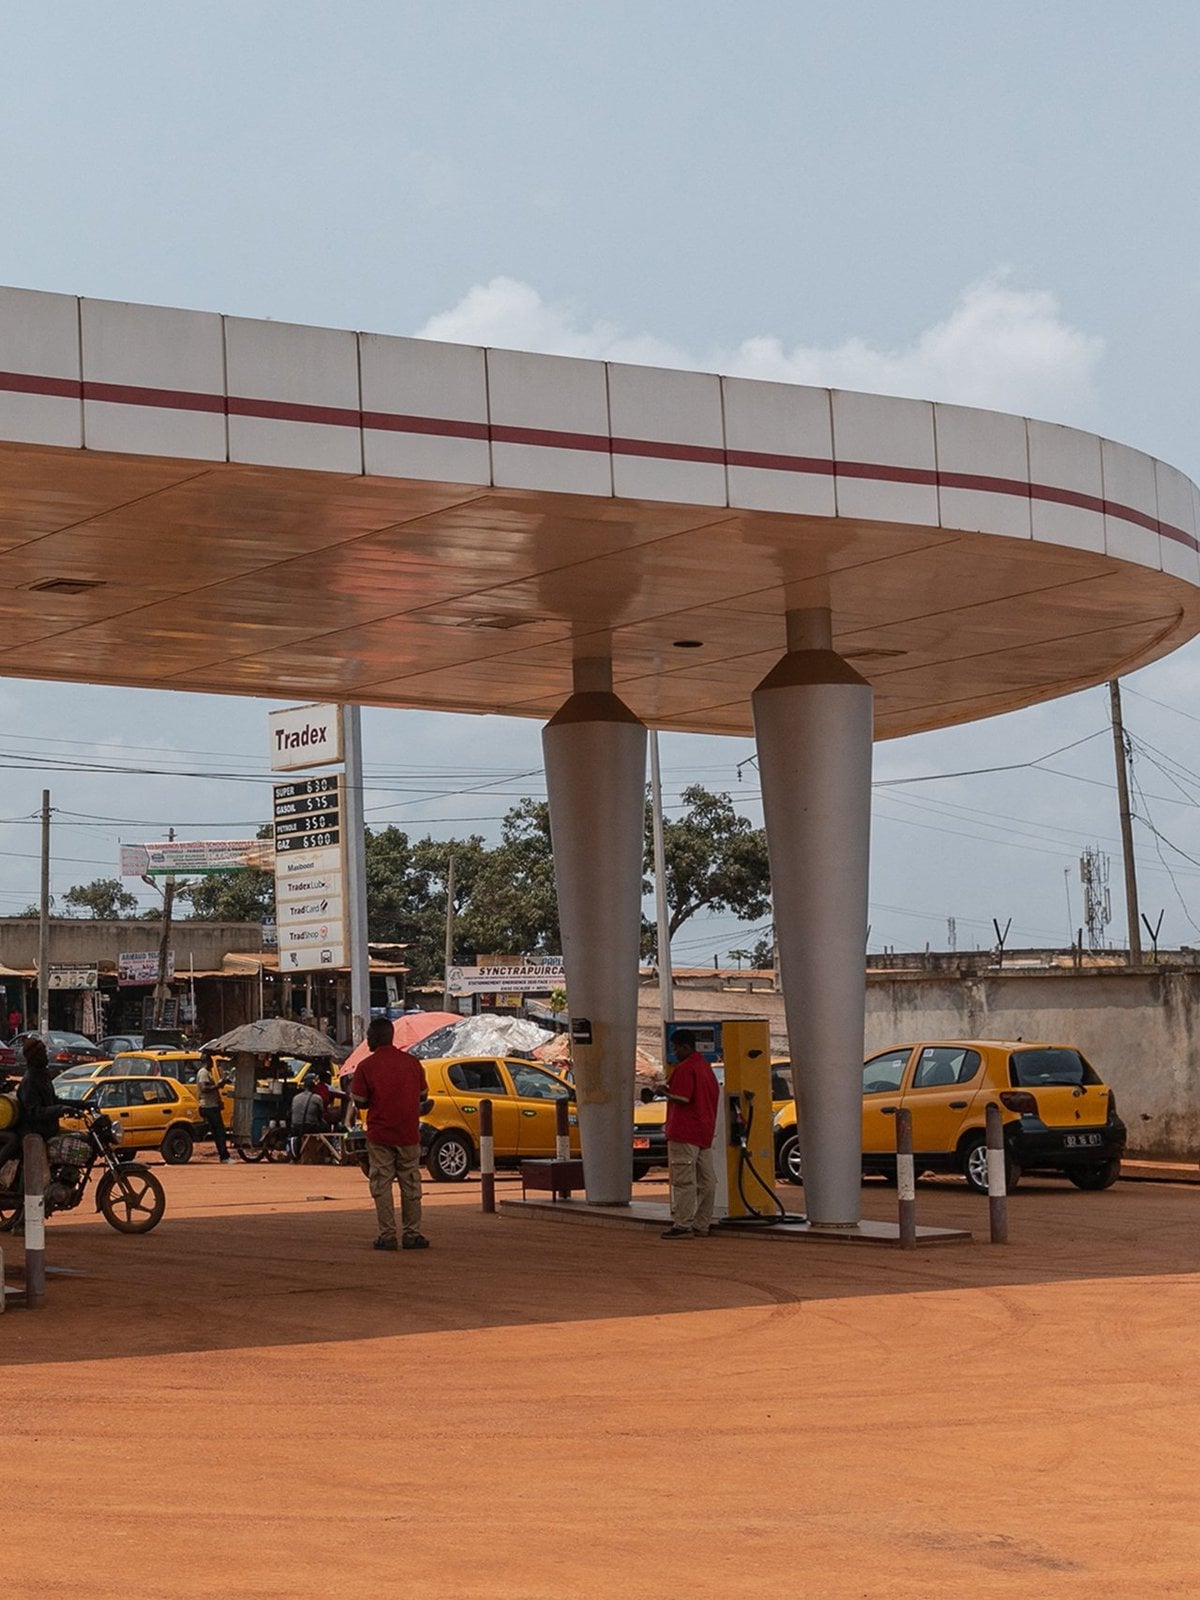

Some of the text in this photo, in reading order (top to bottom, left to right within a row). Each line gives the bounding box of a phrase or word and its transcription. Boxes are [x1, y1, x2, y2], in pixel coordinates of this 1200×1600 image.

[275, 724, 327, 751] Tradex
[275, 780, 328, 798] SUPER 630
[276, 796, 328, 815] GASOIL 575
[277, 816, 326, 833] PETROLE 350
[277, 833, 331, 850] GAZ 6500
[290, 904, 320, 915] TradCard
[289, 931, 319, 941] TradShop
